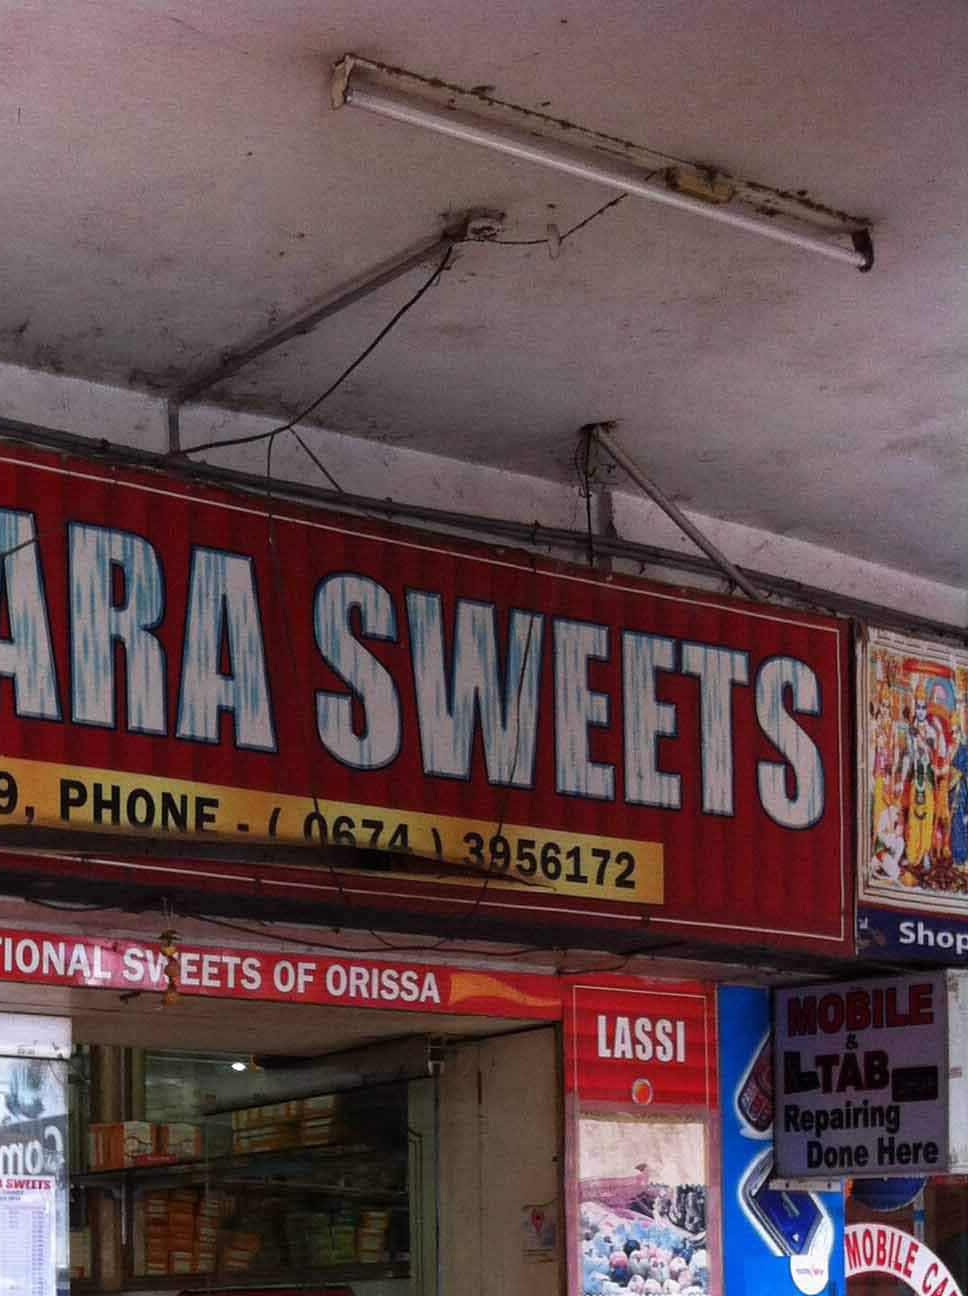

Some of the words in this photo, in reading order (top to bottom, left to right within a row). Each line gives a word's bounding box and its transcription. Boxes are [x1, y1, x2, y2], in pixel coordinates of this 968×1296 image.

[313, 573, 825, 829] SWEETS
[59, 778, 220, 833] PHONE
[463, 832, 637, 890] 3956172
[899, 920, 968, 955] Shop
[122, 946, 263, 991] SWEETS
[272, 959, 317, 994] OF
[325, 964, 442, 1004] ORISSA
[787, 983, 935, 1038] MOBILE
[597, 1014, 686, 1063] LASSI
[784, 1100, 901, 1138] Repairing
[806, 1139, 869, 1169] Done
[877, 1136, 939, 1166] Here
[844, 1229, 920, 1279] MOBILE
